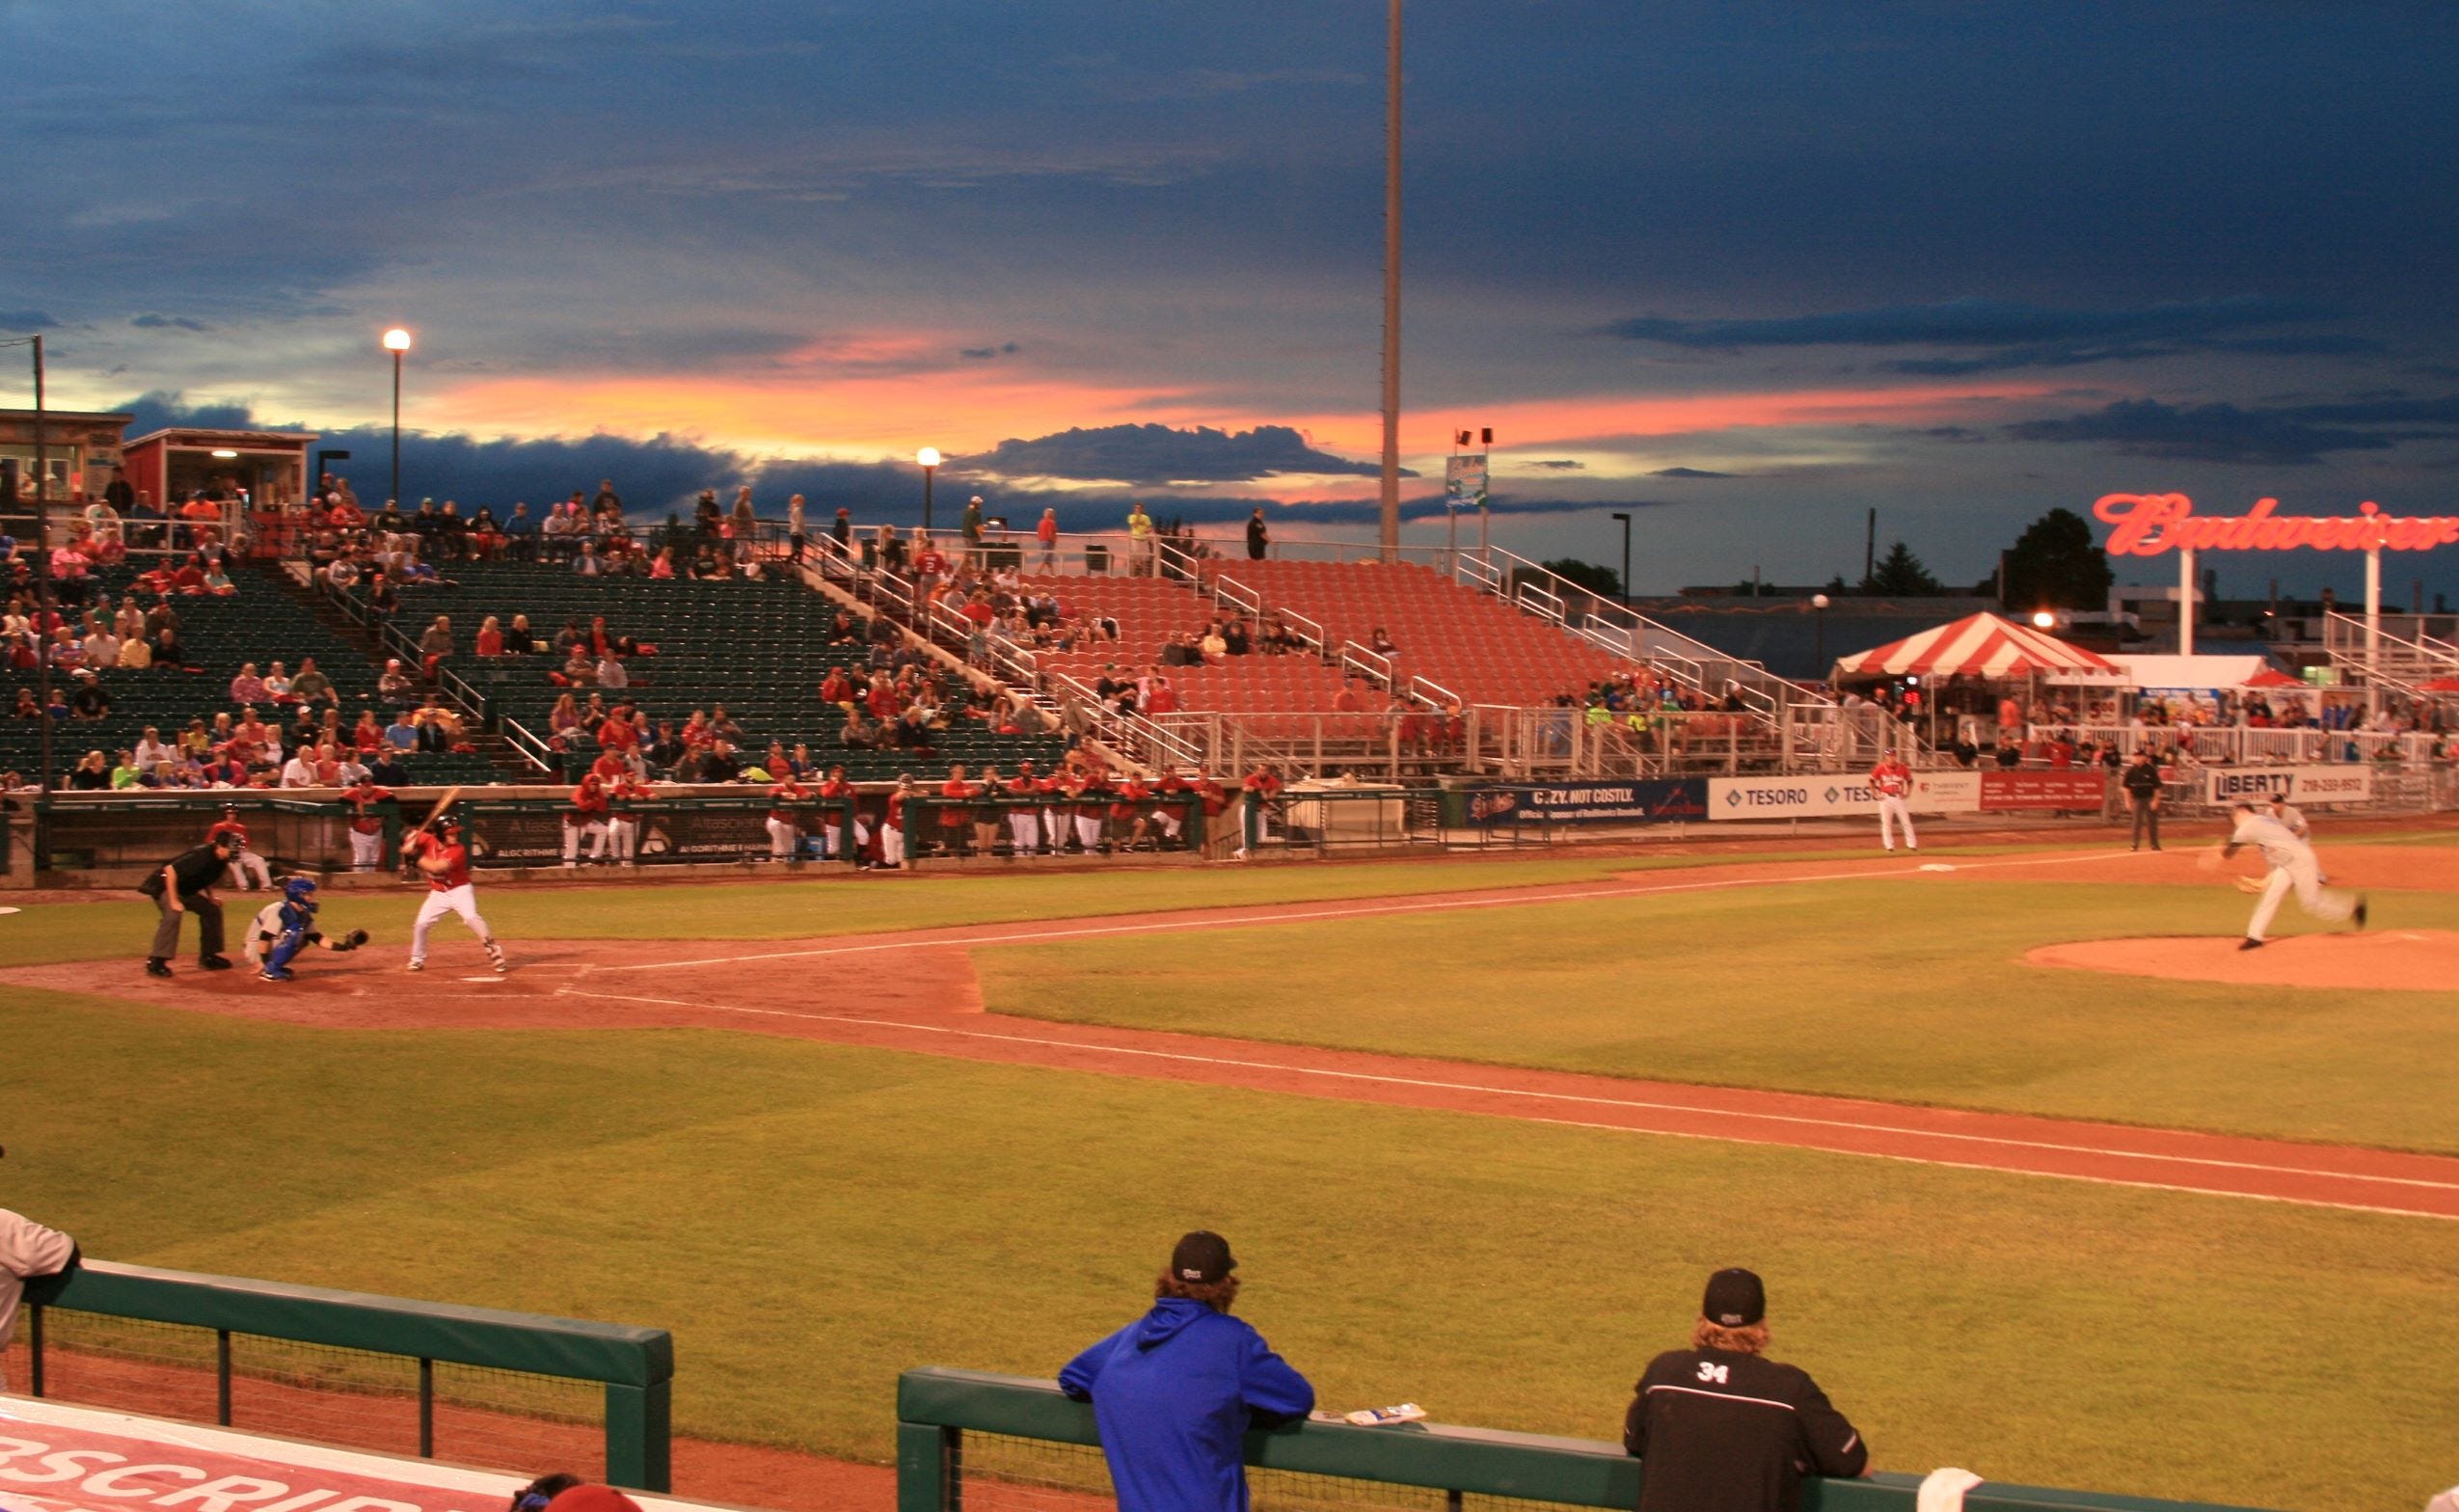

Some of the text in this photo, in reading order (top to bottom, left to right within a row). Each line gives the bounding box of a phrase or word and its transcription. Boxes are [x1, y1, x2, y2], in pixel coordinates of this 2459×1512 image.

[2094, 493, 2459, 556] Budweiser
[1533, 788, 1634, 804] CZY. NOT COSTLY.
[1746, 789, 1807, 804] TESORO
[1696, 1361, 1729, 1385] 34
